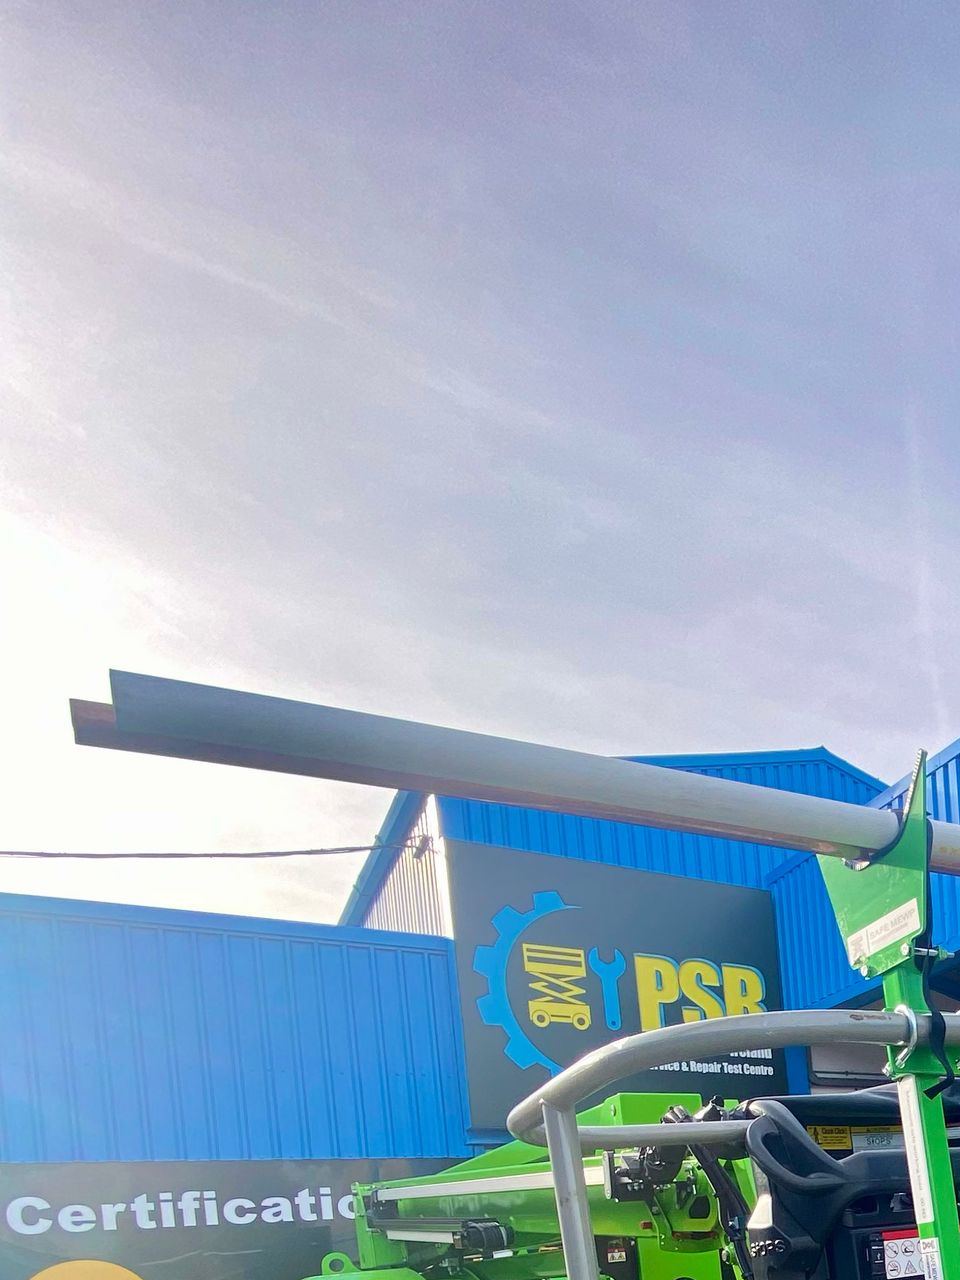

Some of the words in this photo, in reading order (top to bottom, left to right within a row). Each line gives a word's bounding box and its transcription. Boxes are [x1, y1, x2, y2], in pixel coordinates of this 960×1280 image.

[633, 953, 767, 1031] PSR
[681, 1062, 689, 1072] &
[690, 1061, 722, 1074] Repair
[722, 1062, 743, 1074] Test
[743, 1064, 774, 1076] Centre
[5, 1187, 357, 1235] Certificatio
